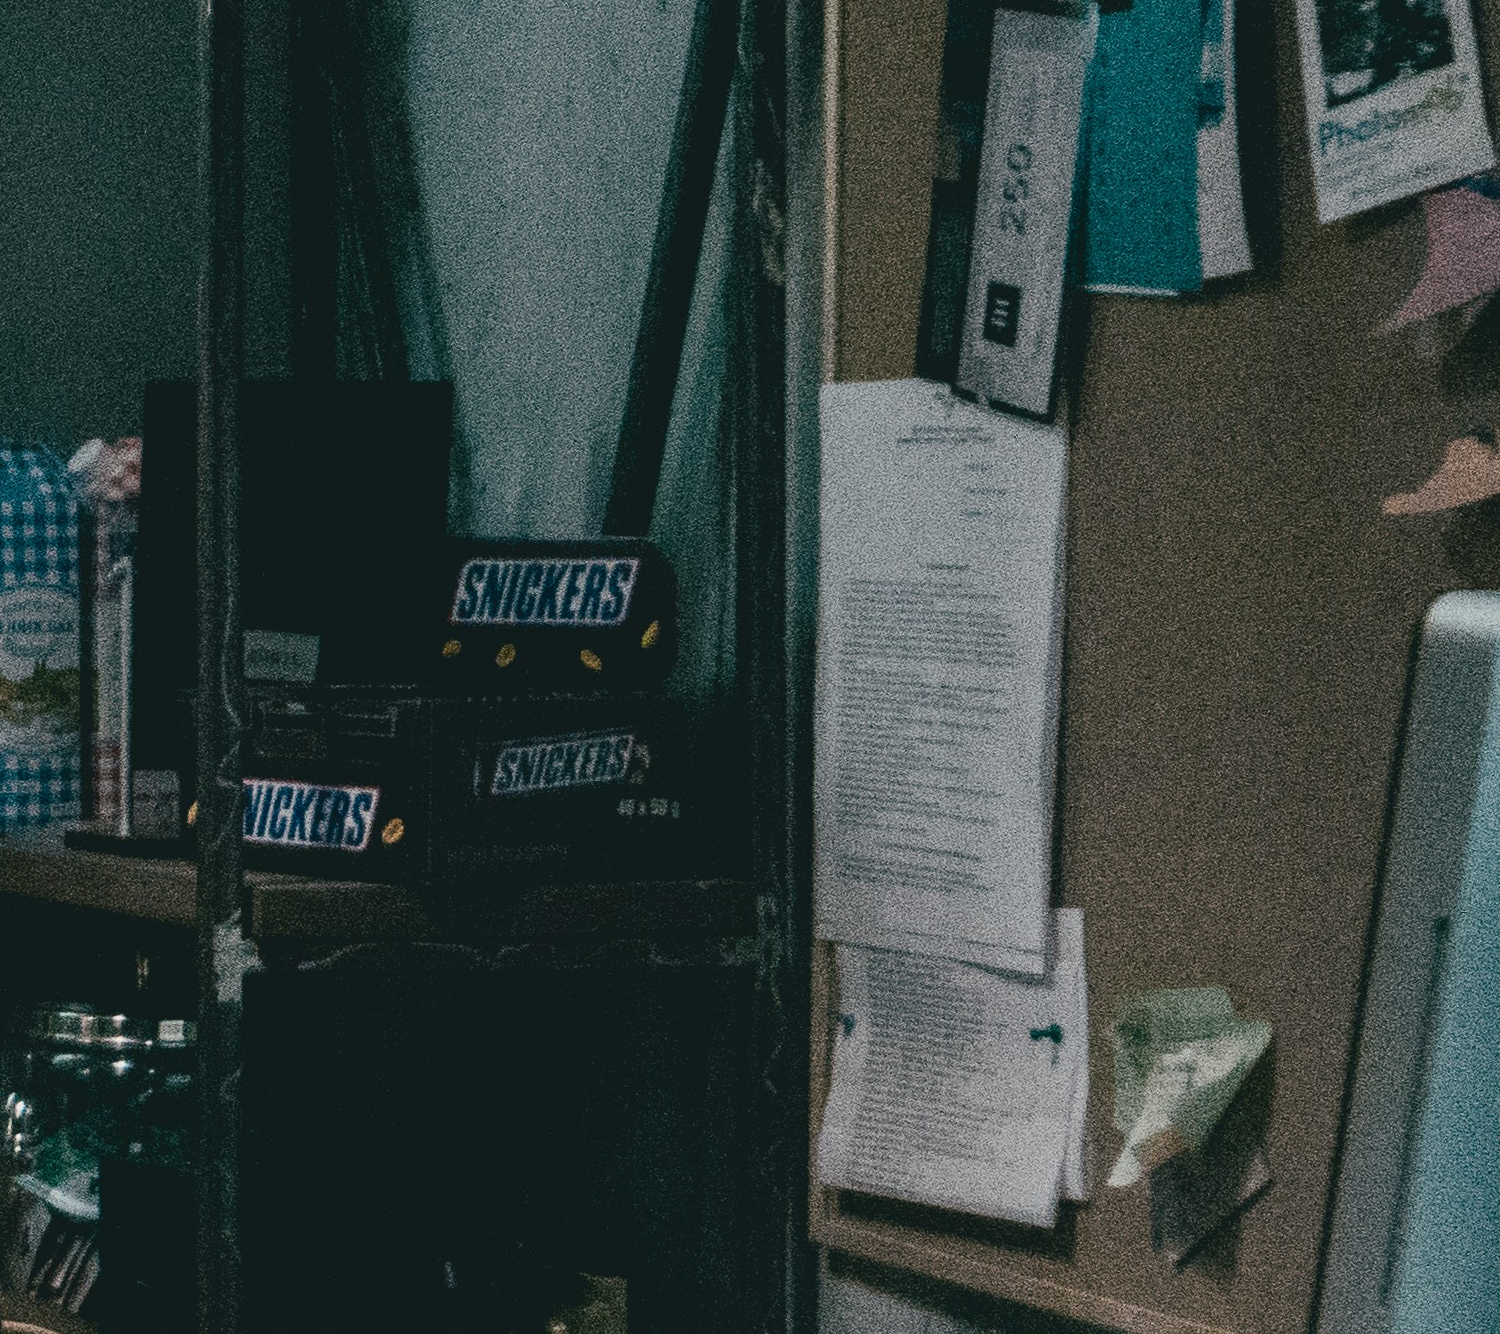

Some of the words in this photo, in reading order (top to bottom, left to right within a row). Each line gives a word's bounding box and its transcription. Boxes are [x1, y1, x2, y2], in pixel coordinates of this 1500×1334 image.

[457, 563, 628, 621] SNICKERS
[497, 736, 629, 790] SNICKERS
[244, 783, 372, 849] NICKERS
